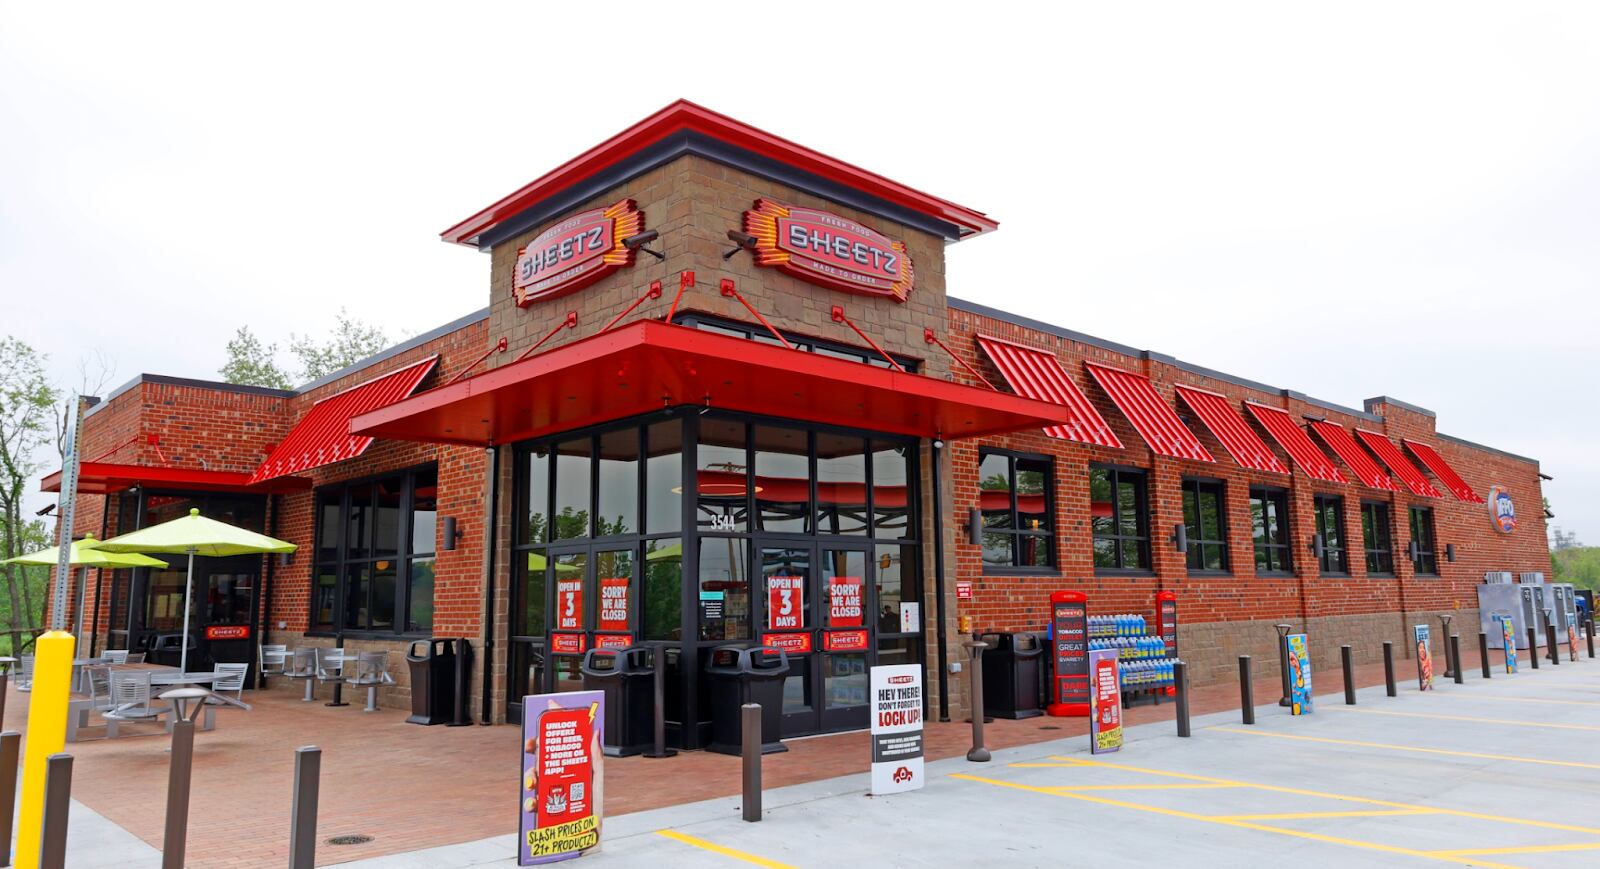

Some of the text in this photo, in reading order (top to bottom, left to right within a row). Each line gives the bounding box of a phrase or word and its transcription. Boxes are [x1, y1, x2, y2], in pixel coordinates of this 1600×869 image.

[821, 216, 871, 237] FRESH FOOD
[521, 224, 604, 281] SHEETZ
[790, 224, 898, 275] SHEETZ
[812, 261, 876, 284] MADE TO ORDER
[710, 514, 736, 531] 3544
[559, 582, 581, 592] OPEN IN
[770, 578, 802, 589] OPEN IN
[602, 586, 627, 599] SORRY
[831, 584, 860, 596] SORRY
[566, 592, 575, 617] 3
[602, 599, 627, 609] WE ARE
[779, 589, 793, 616] 3
[831, 596, 861, 607] WE ARE
[601, 610, 627, 621] CLOSED
[831, 606, 861, 618] CLOSED
[562, 618, 577, 628] DAYS
[775, 616, 797, 627] DAYS
[772, 639, 802, 647] SHEETZ
[832, 636, 860, 644] SHEETZ
[1058, 643, 1083, 651] GREAT
[878, 686, 920, 701] HEY THERE!
[878, 701, 897, 711] DON'T
[898, 699, 915, 709] FORGET
[879, 708, 921, 727] LOCK UP!
[545, 721, 577, 730] UNLOCK
[545, 735, 583, 745] FOR BEER,
[545, 743, 581, 752] TOBACCO
[550, 751, 573, 759] MORE
[573, 749, 584, 757] ON
[545, 756, 588, 767] THE SHEETZ
[544, 767, 565, 775] APP!
[528, 817, 594, 844] SLASH PRICES ON
[533, 833, 594, 856] 21+ PRODUCTZ!
